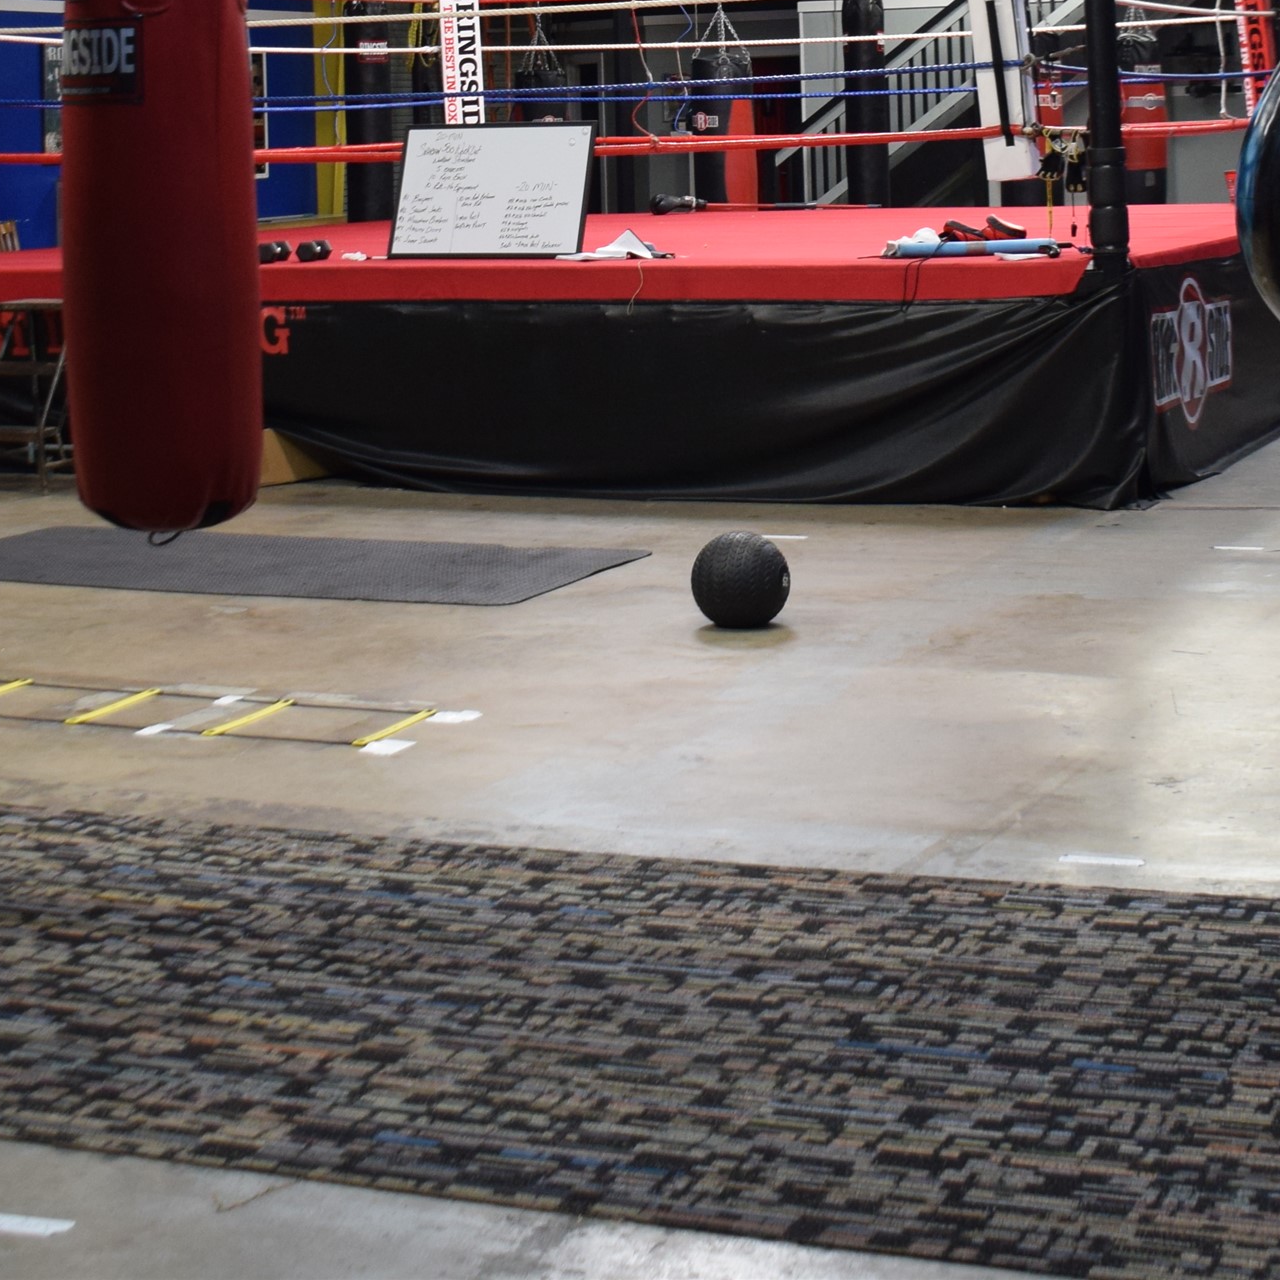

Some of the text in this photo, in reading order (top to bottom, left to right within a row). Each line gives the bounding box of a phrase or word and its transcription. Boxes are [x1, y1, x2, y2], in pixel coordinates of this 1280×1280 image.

[443, 4, 454, 34] THE
[444, 37, 456, 70] BEST
[456, 3, 481, 124] RINGSID
[446, 71, 457, 90] IN
